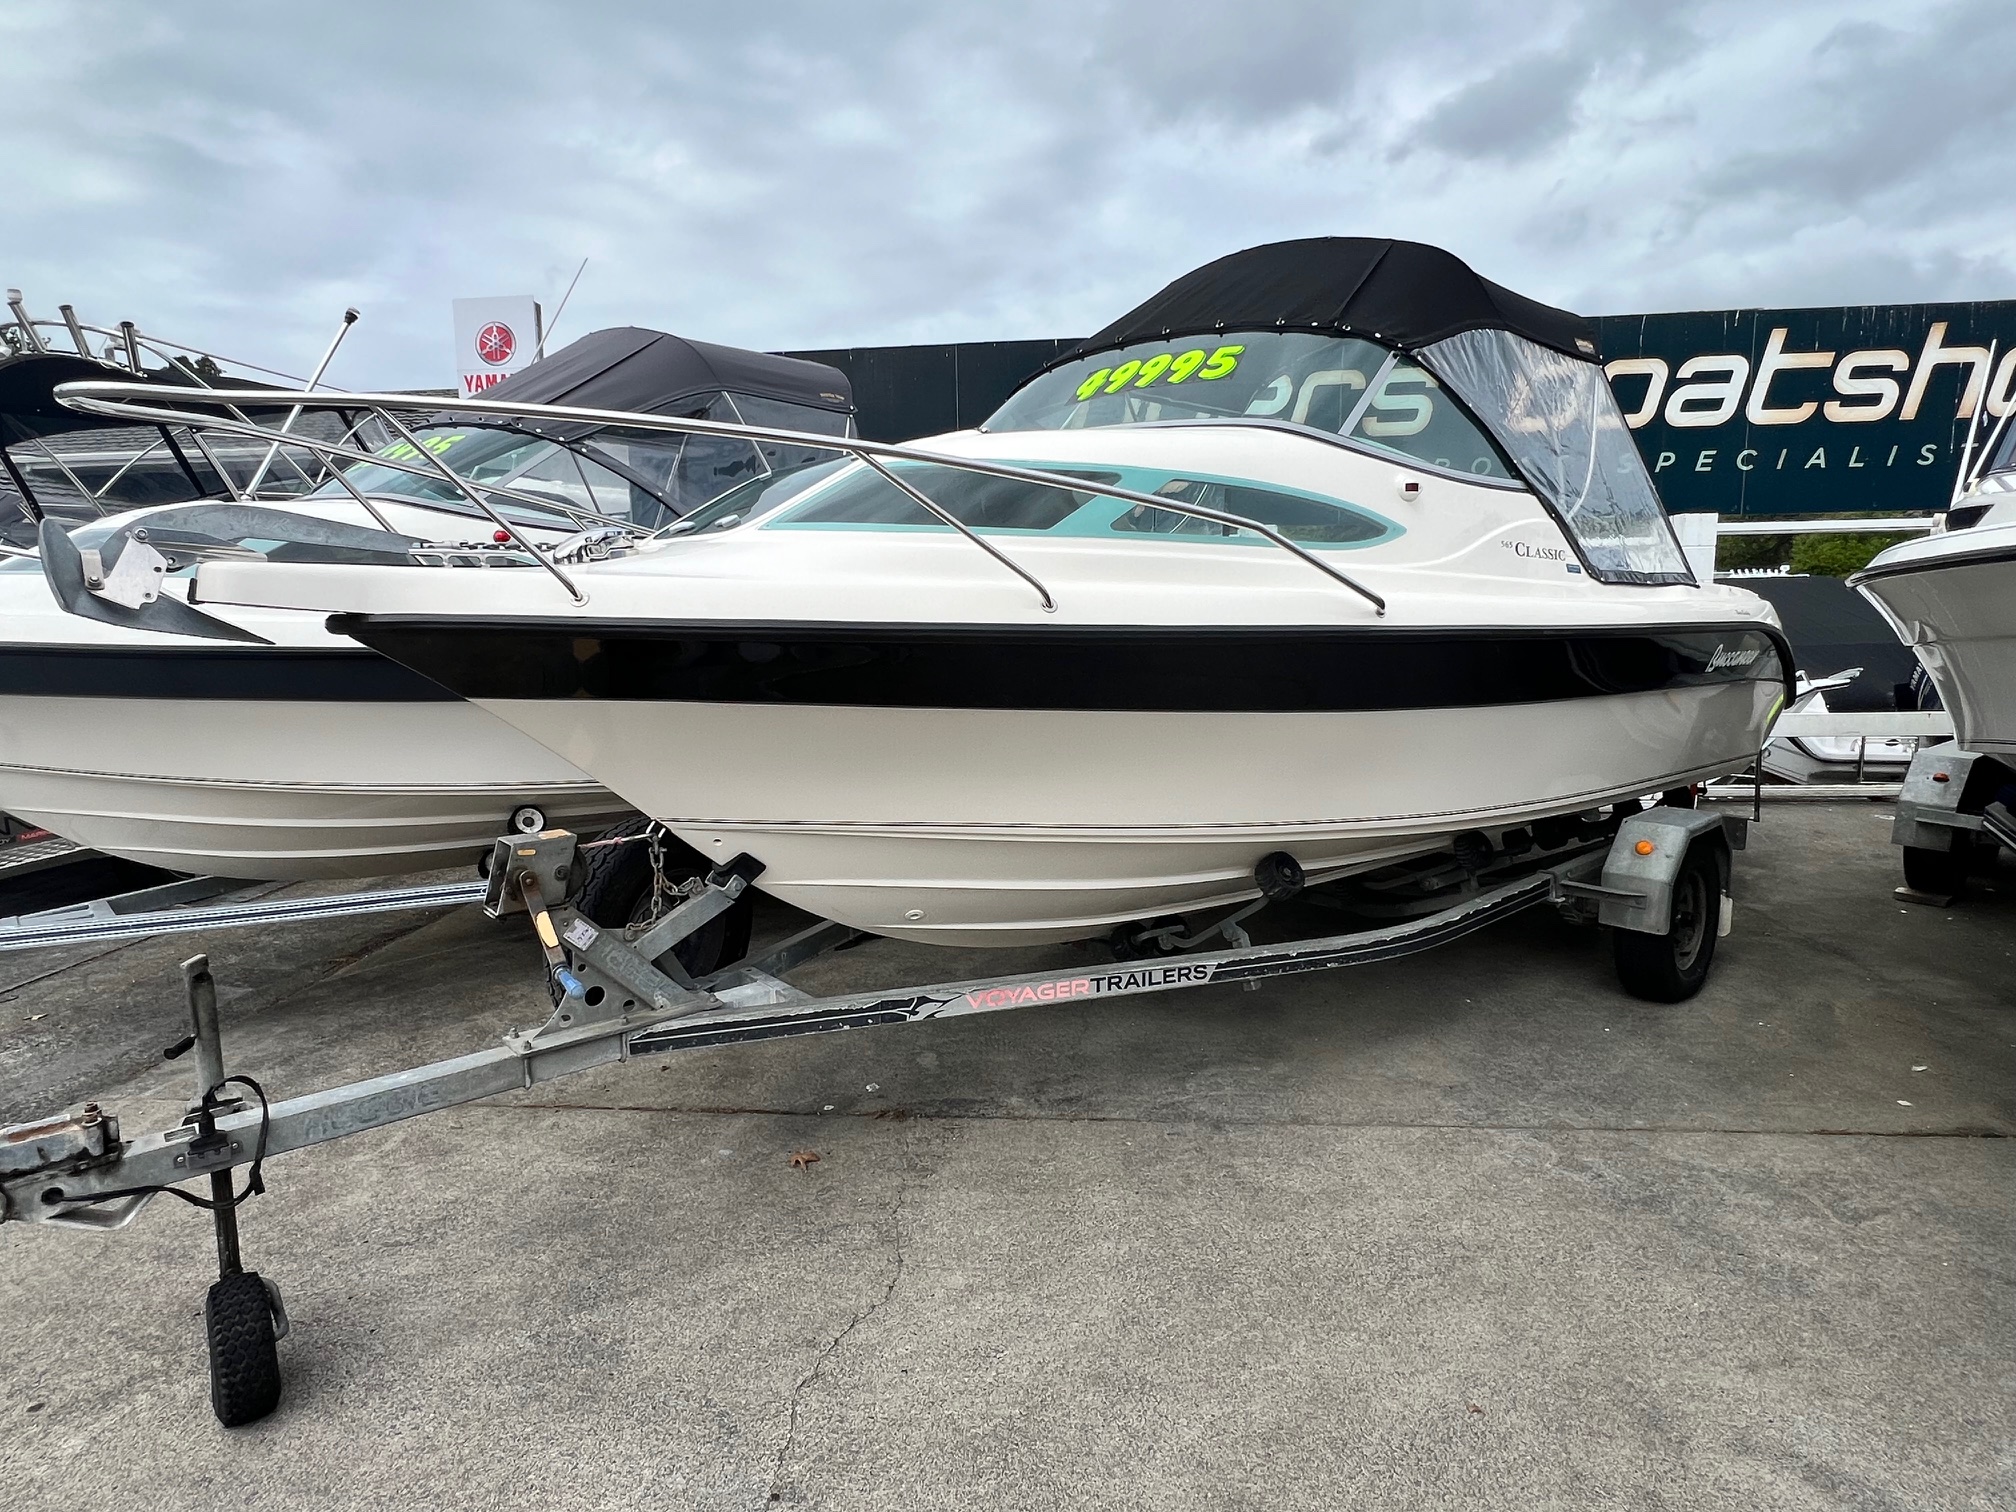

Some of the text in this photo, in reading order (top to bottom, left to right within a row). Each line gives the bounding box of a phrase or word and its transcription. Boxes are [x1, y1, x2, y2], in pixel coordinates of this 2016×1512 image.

[463, 372, 516, 393] YAM
[1500, 540, 1513, 549] 565
[966, 964, 1208, 1010] VOYAGER TRAILERS
